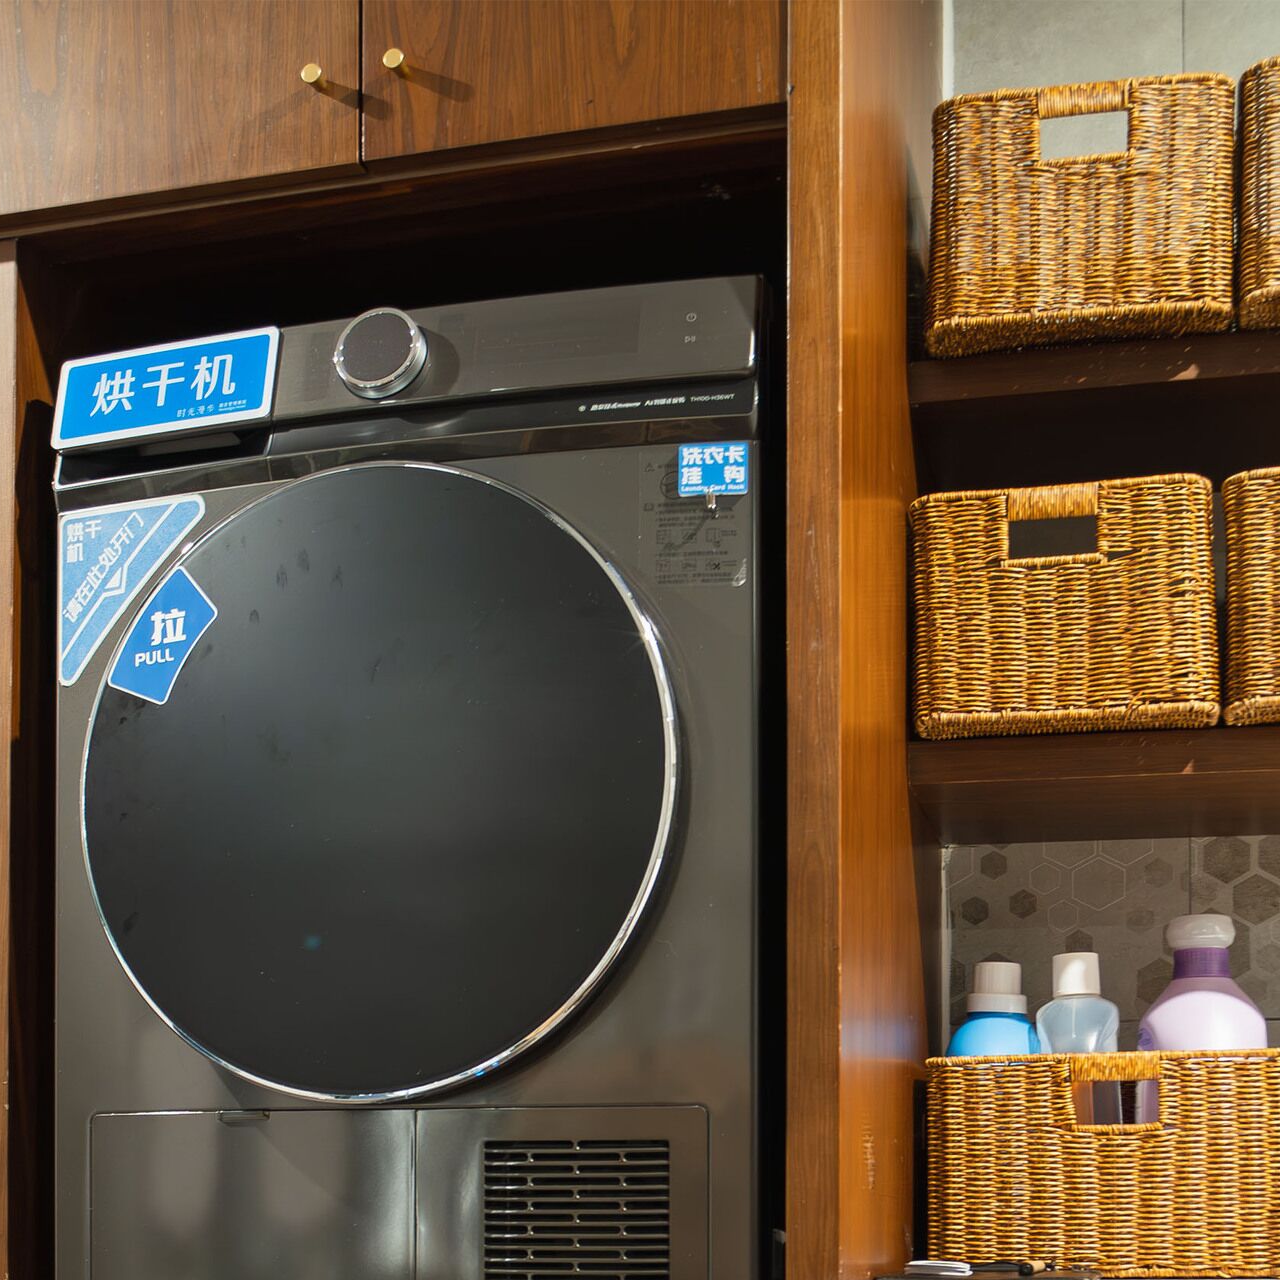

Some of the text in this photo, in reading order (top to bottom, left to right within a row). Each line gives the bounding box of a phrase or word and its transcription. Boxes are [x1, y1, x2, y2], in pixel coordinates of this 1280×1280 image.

[90, 354, 236, 417] 烘干机
[682, 446, 744, 465] 洗衣卡
[67, 519, 102, 543] 烘干
[63, 511, 144, 623] 请在此处开门
[150, 608, 186, 646] 拉
[135, 648, 174, 667] PULL
